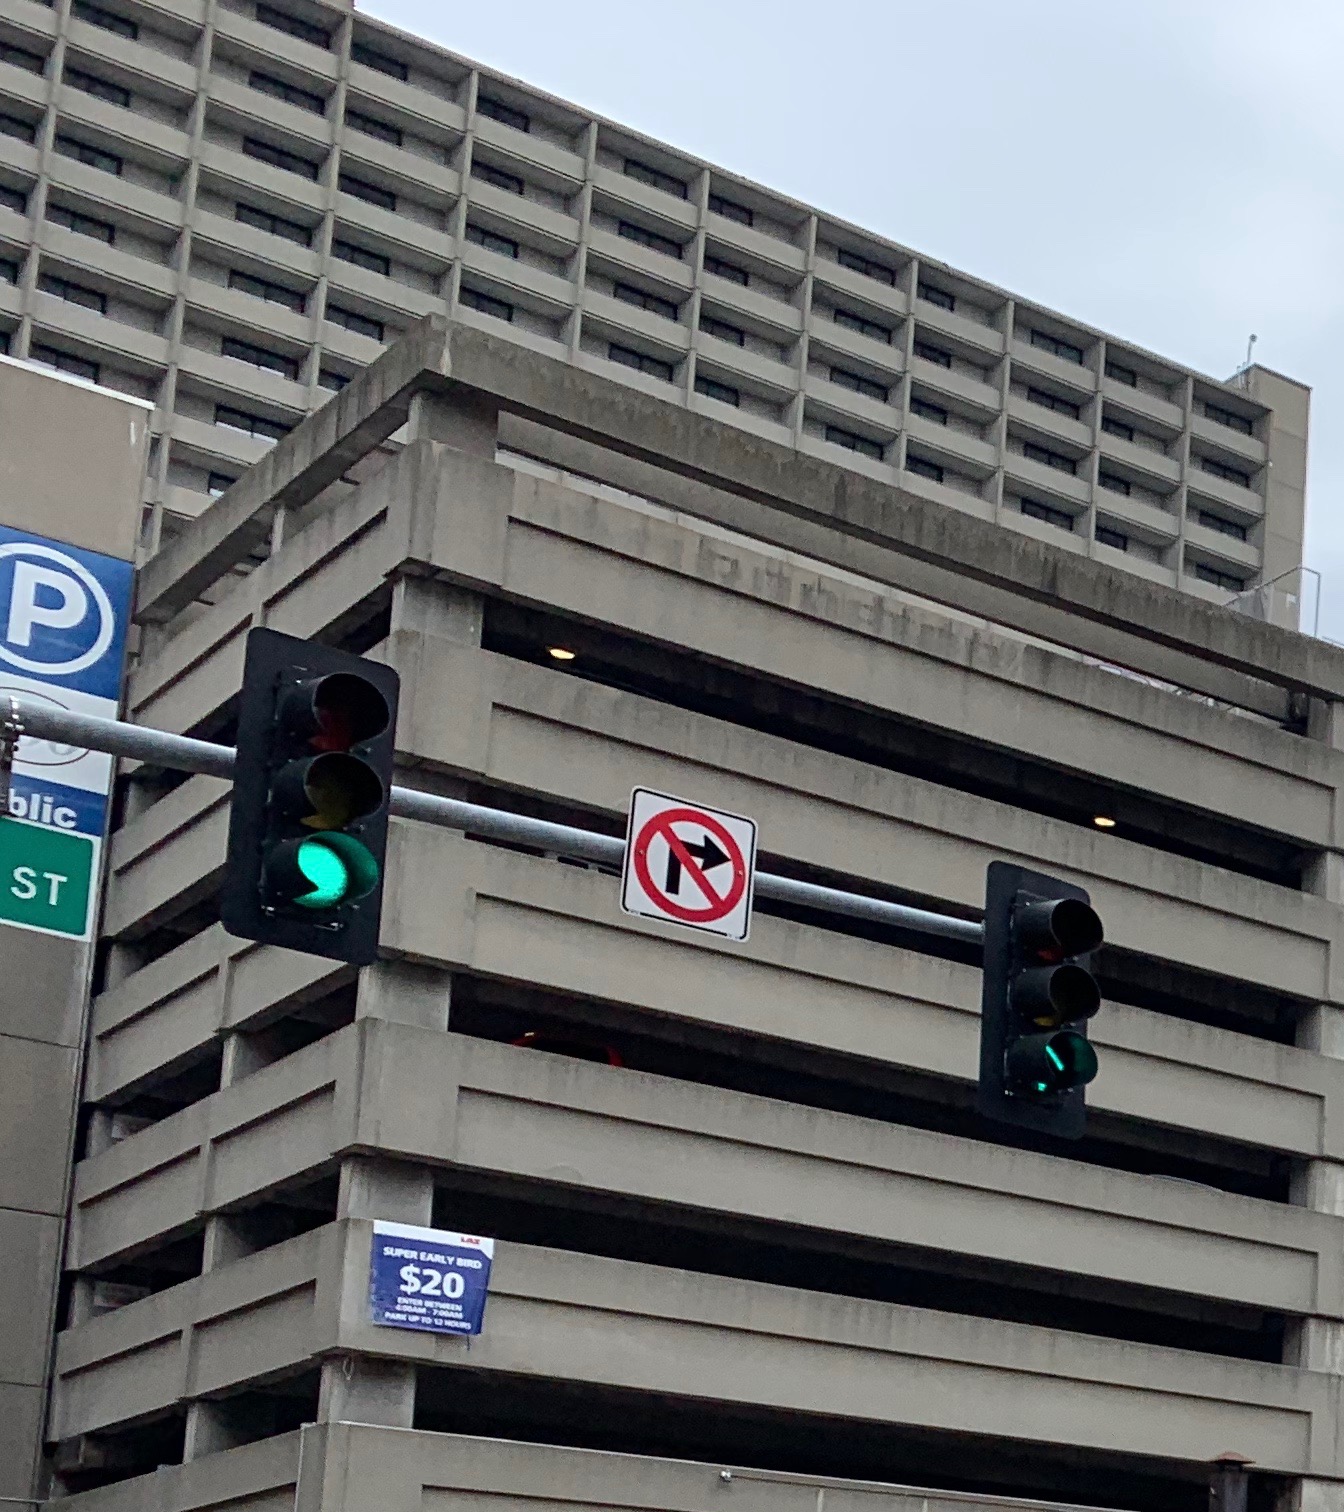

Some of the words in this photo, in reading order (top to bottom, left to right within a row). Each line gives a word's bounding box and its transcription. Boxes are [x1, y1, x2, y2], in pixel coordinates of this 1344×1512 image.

[10, 866, 68, 906] ST
[383, 1246, 418, 1260] SUPER
[419, 1251, 455, 1266] EARLY
[456, 1257, 483, 1269] BIRD
[399, 1263, 465, 1299] $20
[397, 1296, 423, 1307] ENTER
[424, 1300, 463, 1312] BETWEEN
[384, 1311, 407, 1322] PARK
[407, 1314, 420, 1323] UP
[421, 1316, 433, 1325] TO
[444, 1319, 472, 1331] HOURS
